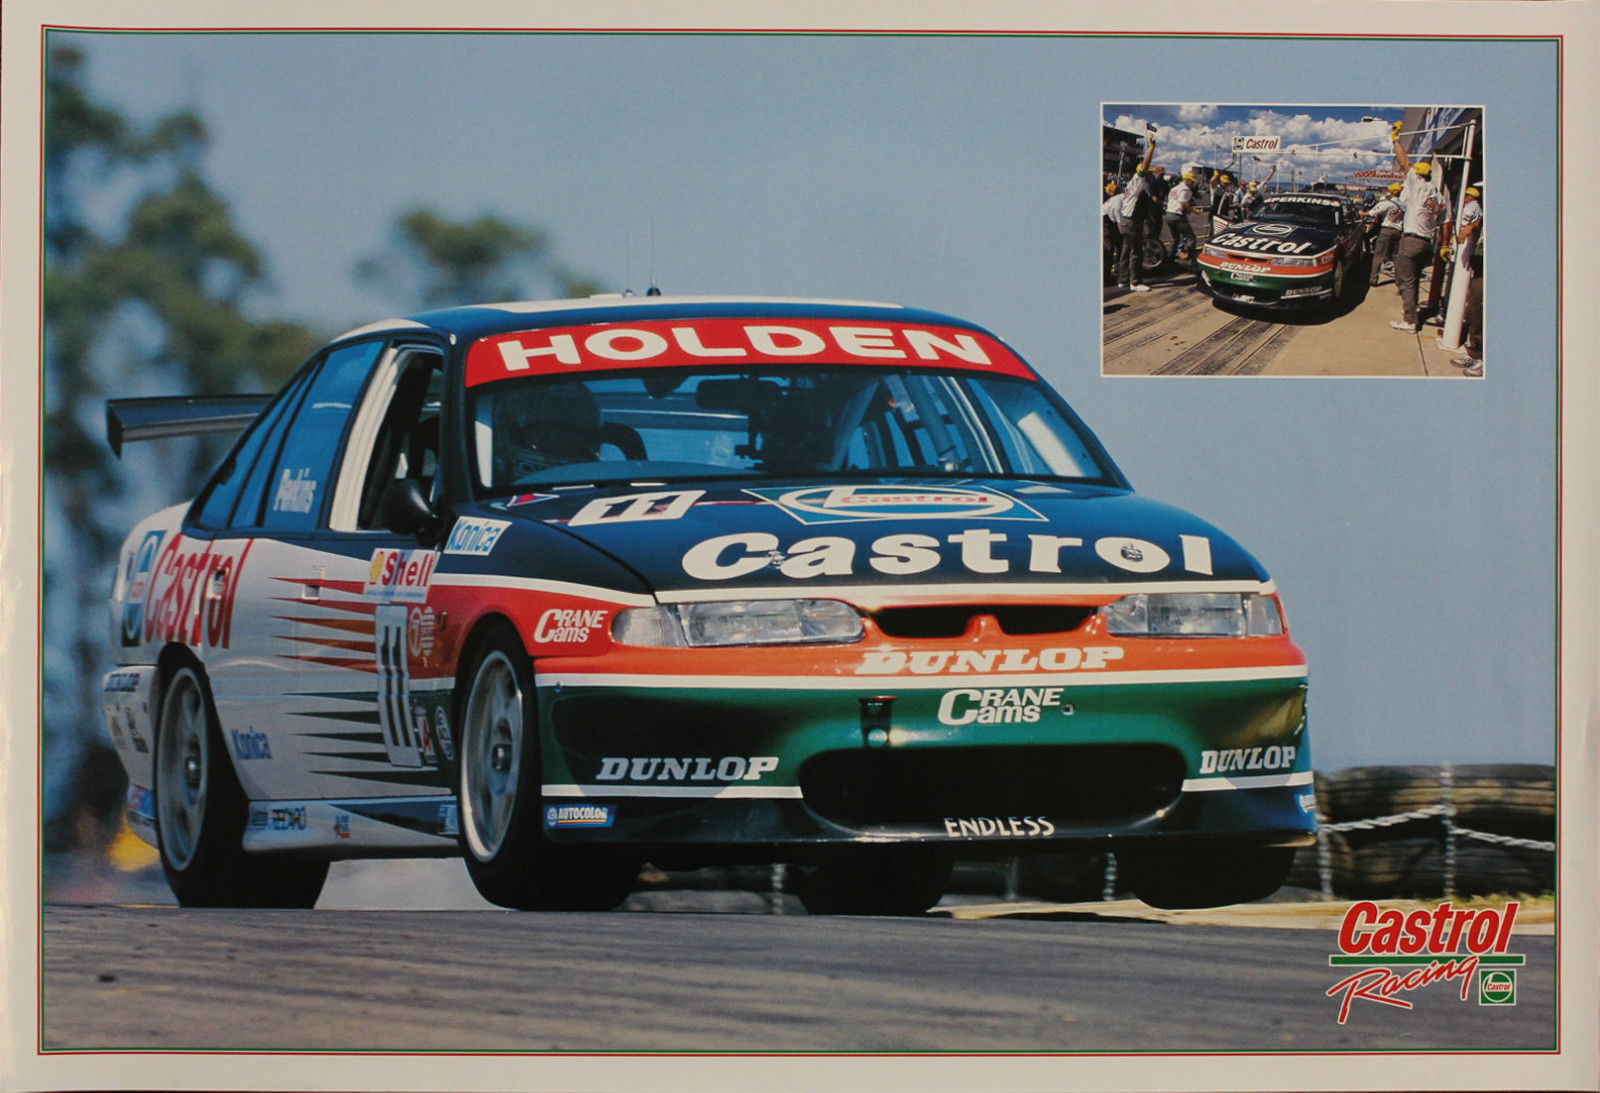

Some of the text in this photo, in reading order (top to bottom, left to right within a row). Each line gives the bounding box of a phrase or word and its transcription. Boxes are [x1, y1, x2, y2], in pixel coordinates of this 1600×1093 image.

[1246, 138, 1279, 150] Castrol
[1271, 196, 1332, 206] PERKINS
[1211, 232, 1313, 254] Castrol
[1219, 261, 1272, 273] DUNLOP
[497, 325, 993, 371] HOLDEN
[840, 496, 988, 504] Castrol
[446, 519, 502, 552] Konica
[682, 528, 1214, 581] Castrol
[382, 551, 434, 587] Shell
[145, 532, 254, 649] Castrol
[534, 608, 608, 634] CRANE
[855, 646, 1124, 675] DUNLOP
[938, 687, 1064, 714] CRANE
[596, 756, 779, 780] DUNLOP
[1200, 746, 1296, 774] DUNLOP
[559, 807, 608, 820] AUTOCOLOR
[943, 816, 1056, 838] ENDLESS
[1338, 901, 1520, 954] Castrol
[1326, 955, 1480, 1025] Racing
[1486, 983, 1511, 992] Castrol
